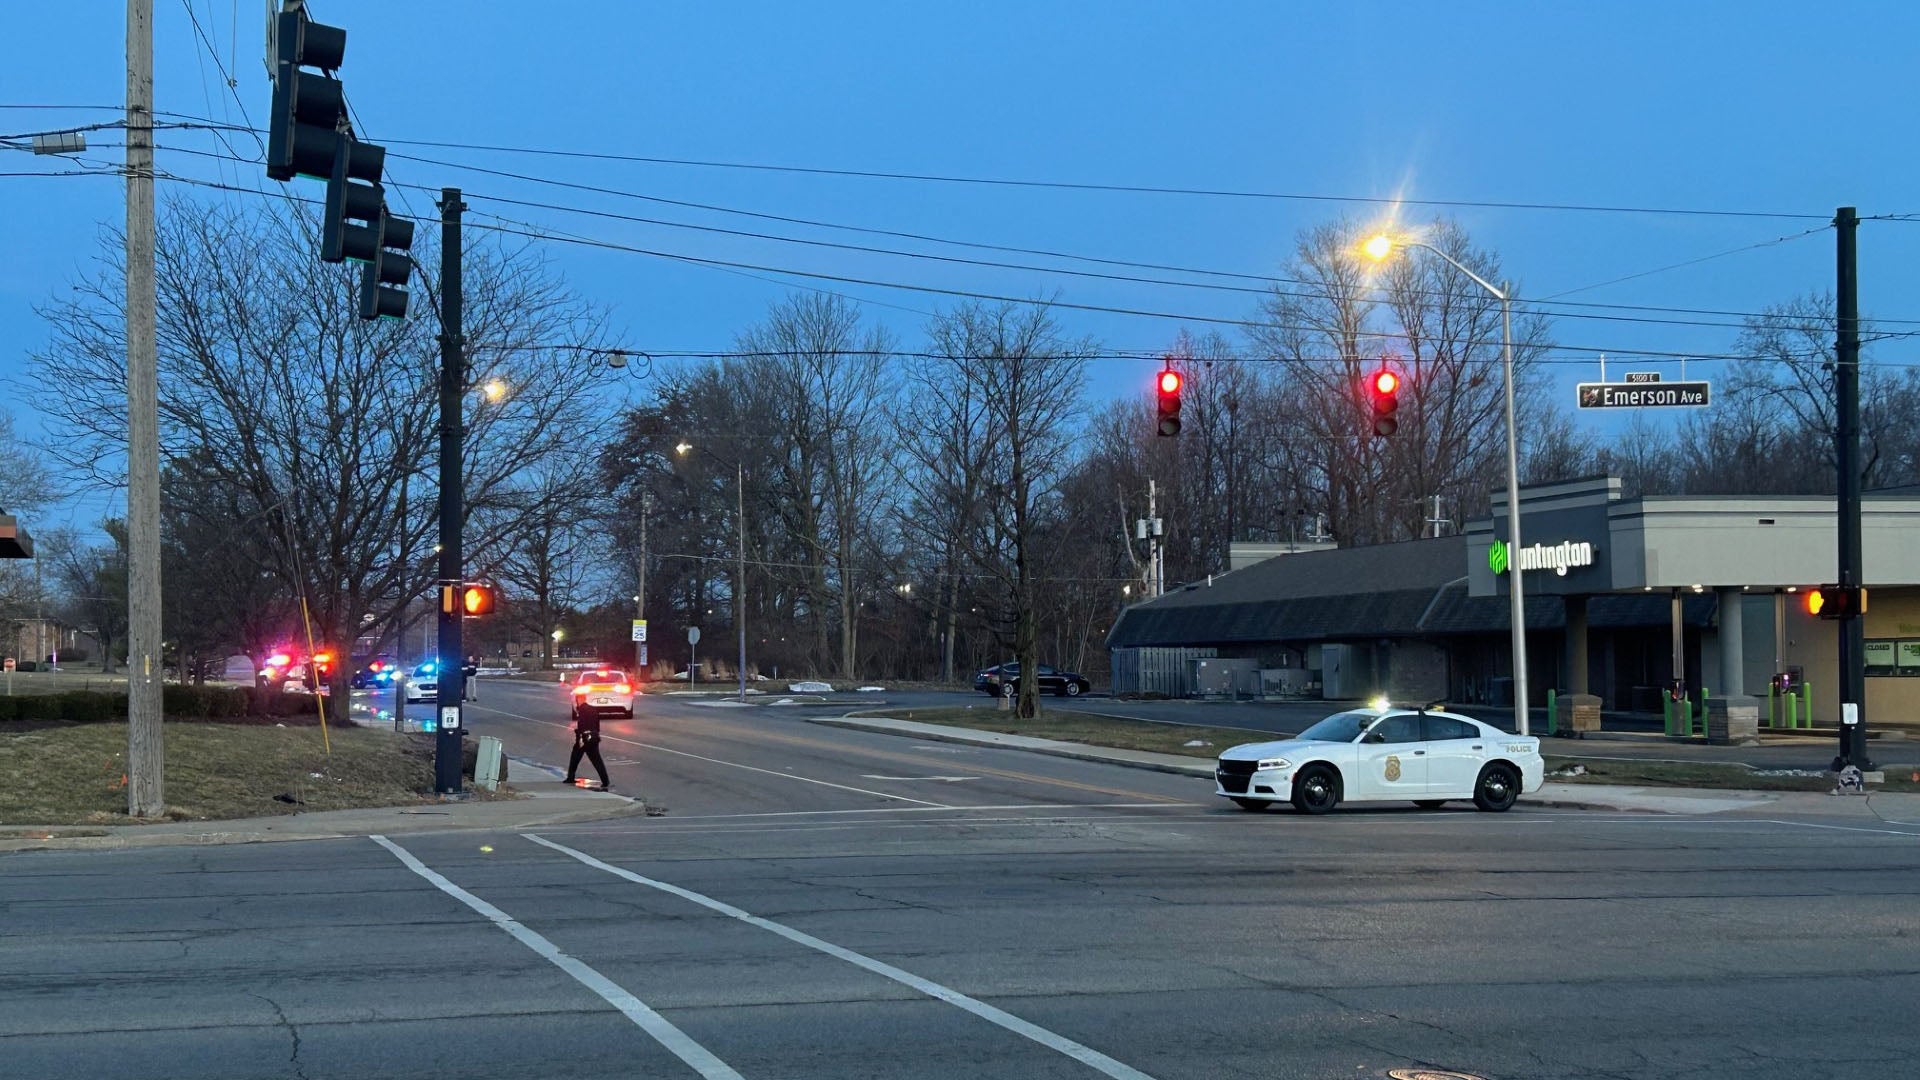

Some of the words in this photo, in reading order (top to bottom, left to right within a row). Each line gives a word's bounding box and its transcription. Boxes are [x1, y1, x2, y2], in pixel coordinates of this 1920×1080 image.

[1604, 388, 1676, 405] Emerson
[1681, 391, 1703, 403] Ave
[1507, 541, 1591, 576] untington
